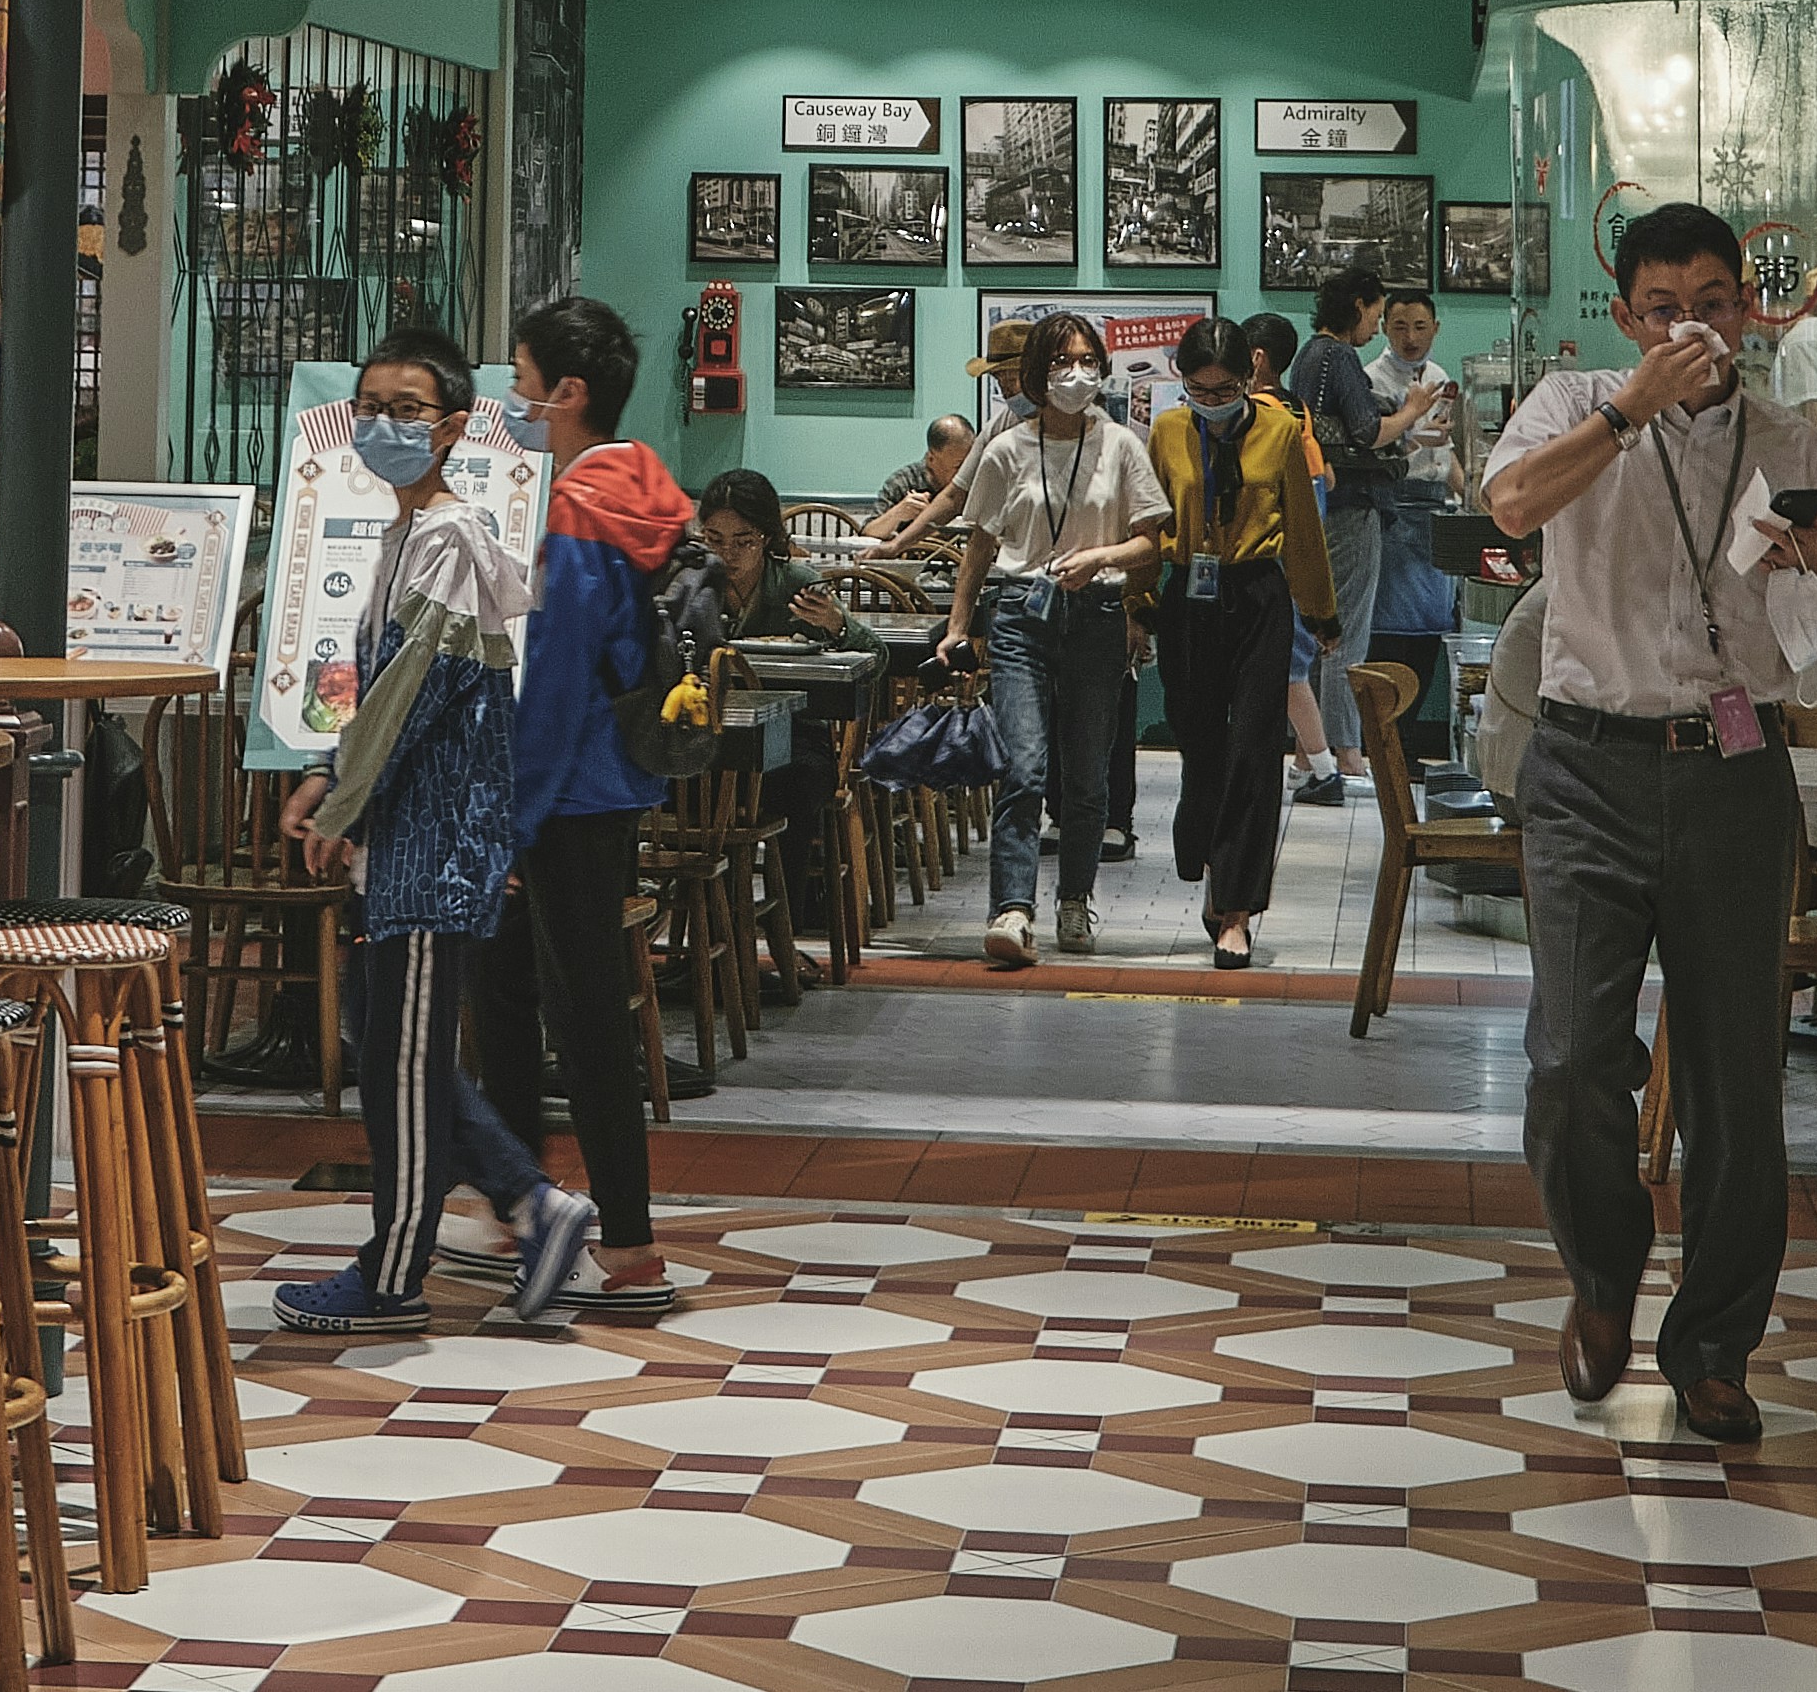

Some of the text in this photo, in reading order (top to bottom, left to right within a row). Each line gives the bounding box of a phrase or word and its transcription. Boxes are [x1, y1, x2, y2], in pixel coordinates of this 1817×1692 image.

[794, 100, 912, 122] Causeway Bay
[1283, 105, 1367, 125] Admiralty
[816, 123, 888, 144] 銅鑼灣
[1300, 128, 1348, 148] 金鐘
[1754, 254, 1800, 293] 粥
[297, 1313, 352, 1332] crocs
